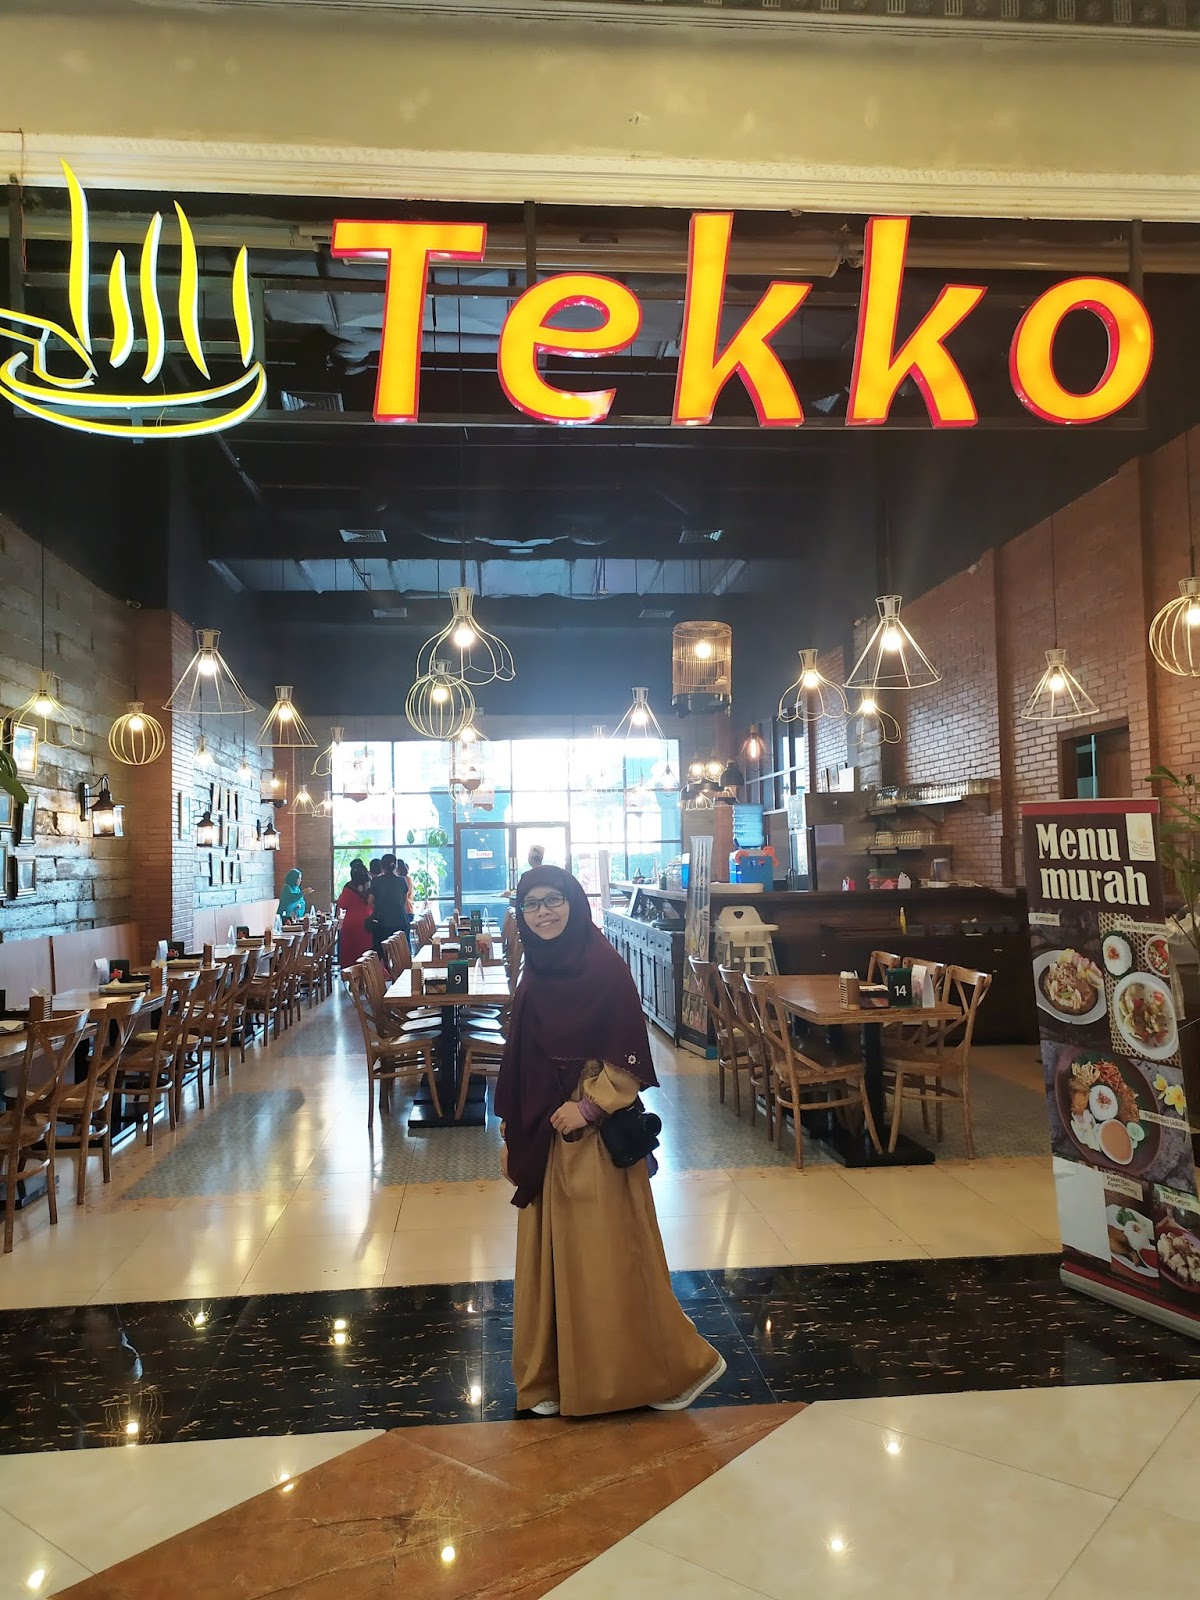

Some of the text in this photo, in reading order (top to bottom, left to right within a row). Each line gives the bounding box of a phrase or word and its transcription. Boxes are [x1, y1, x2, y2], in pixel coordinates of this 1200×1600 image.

[331, 212, 1153, 428] Tekko
[1036, 824, 1121, 861] Menu
[1040, 866, 1150, 906] murah
[464, 945, 473, 953] 10
[454, 974, 462, 984] 9
[893, 984, 907, 997] 14
